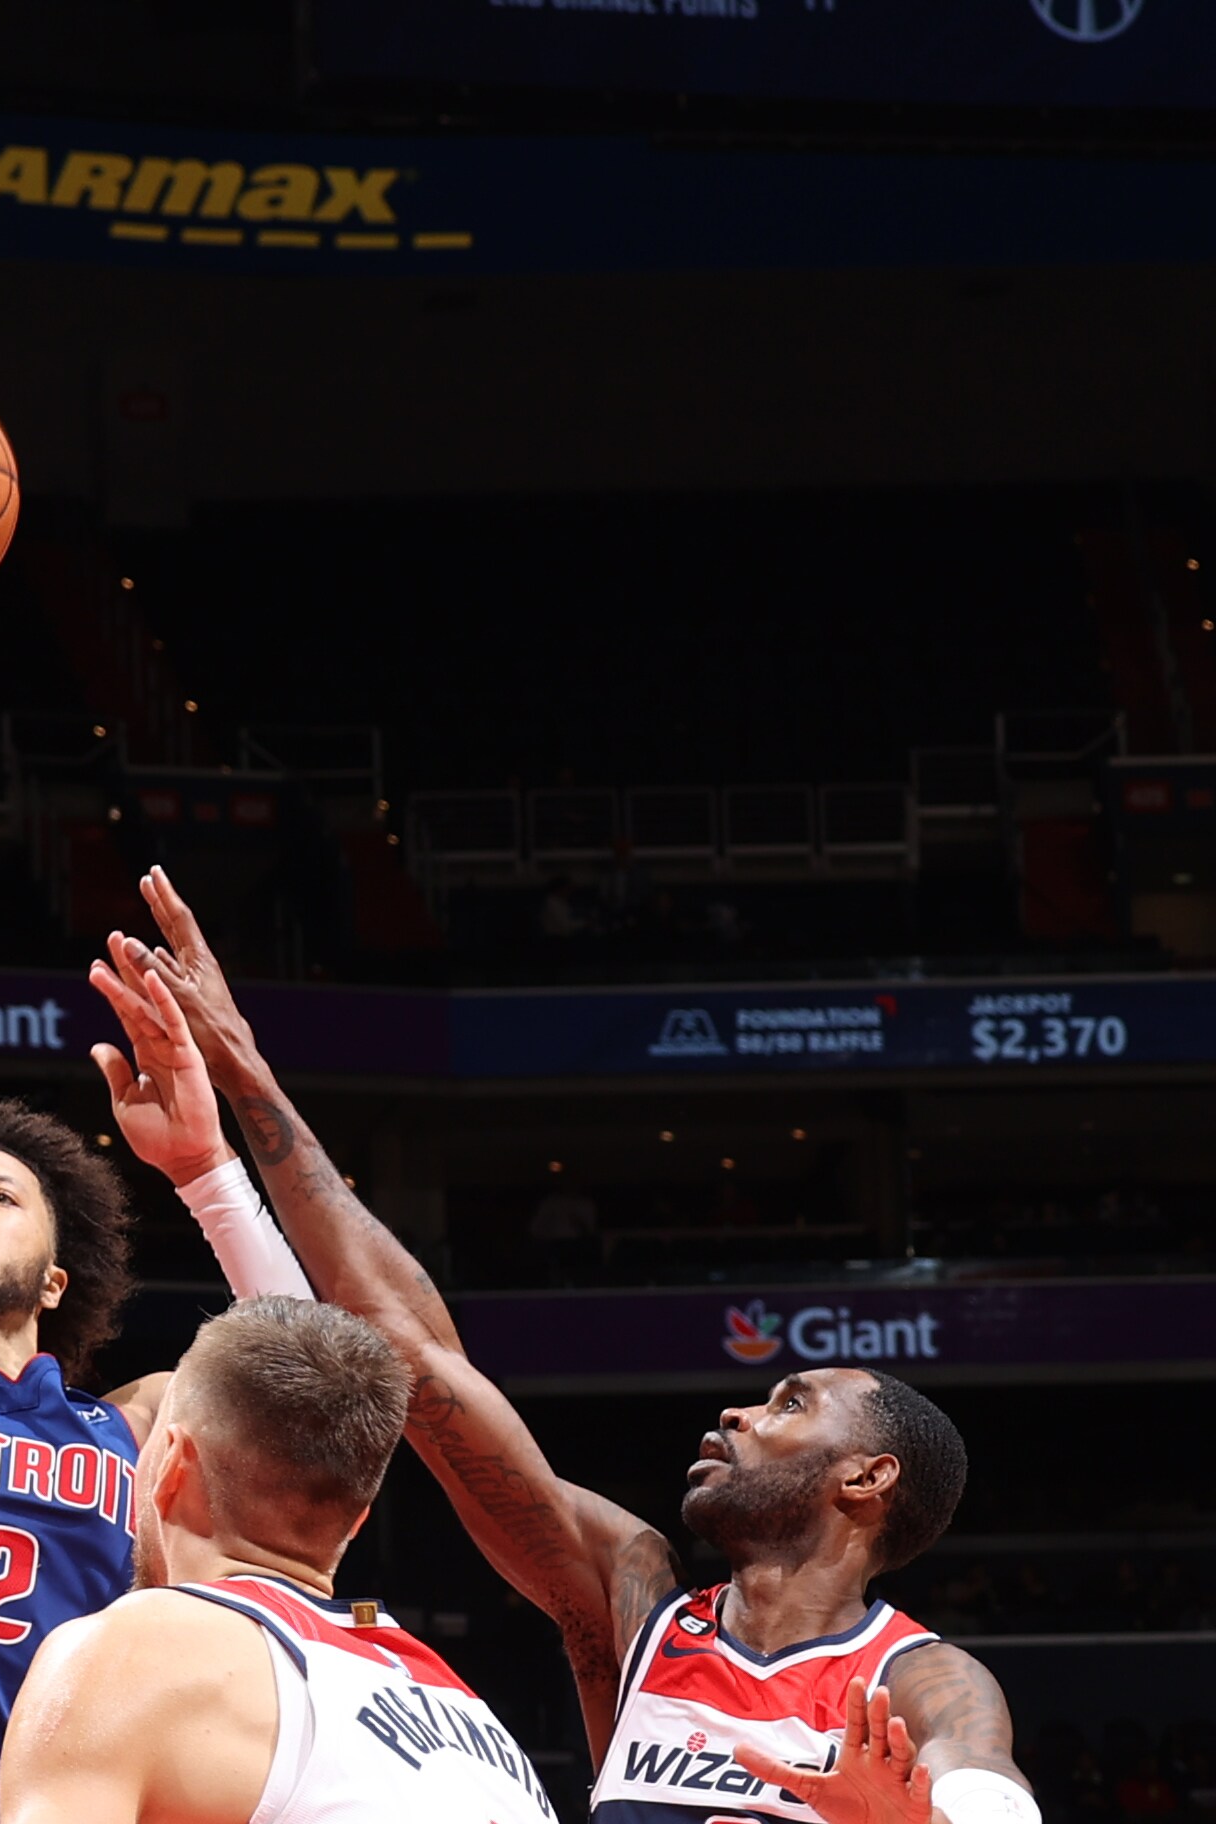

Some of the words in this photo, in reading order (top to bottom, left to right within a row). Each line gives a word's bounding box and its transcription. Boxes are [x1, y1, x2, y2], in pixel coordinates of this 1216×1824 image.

[971, 1015, 1129, 1064] $2,370
[787, 1306, 940, 1361] Giant
[678, 1614, 709, 1636] 6
